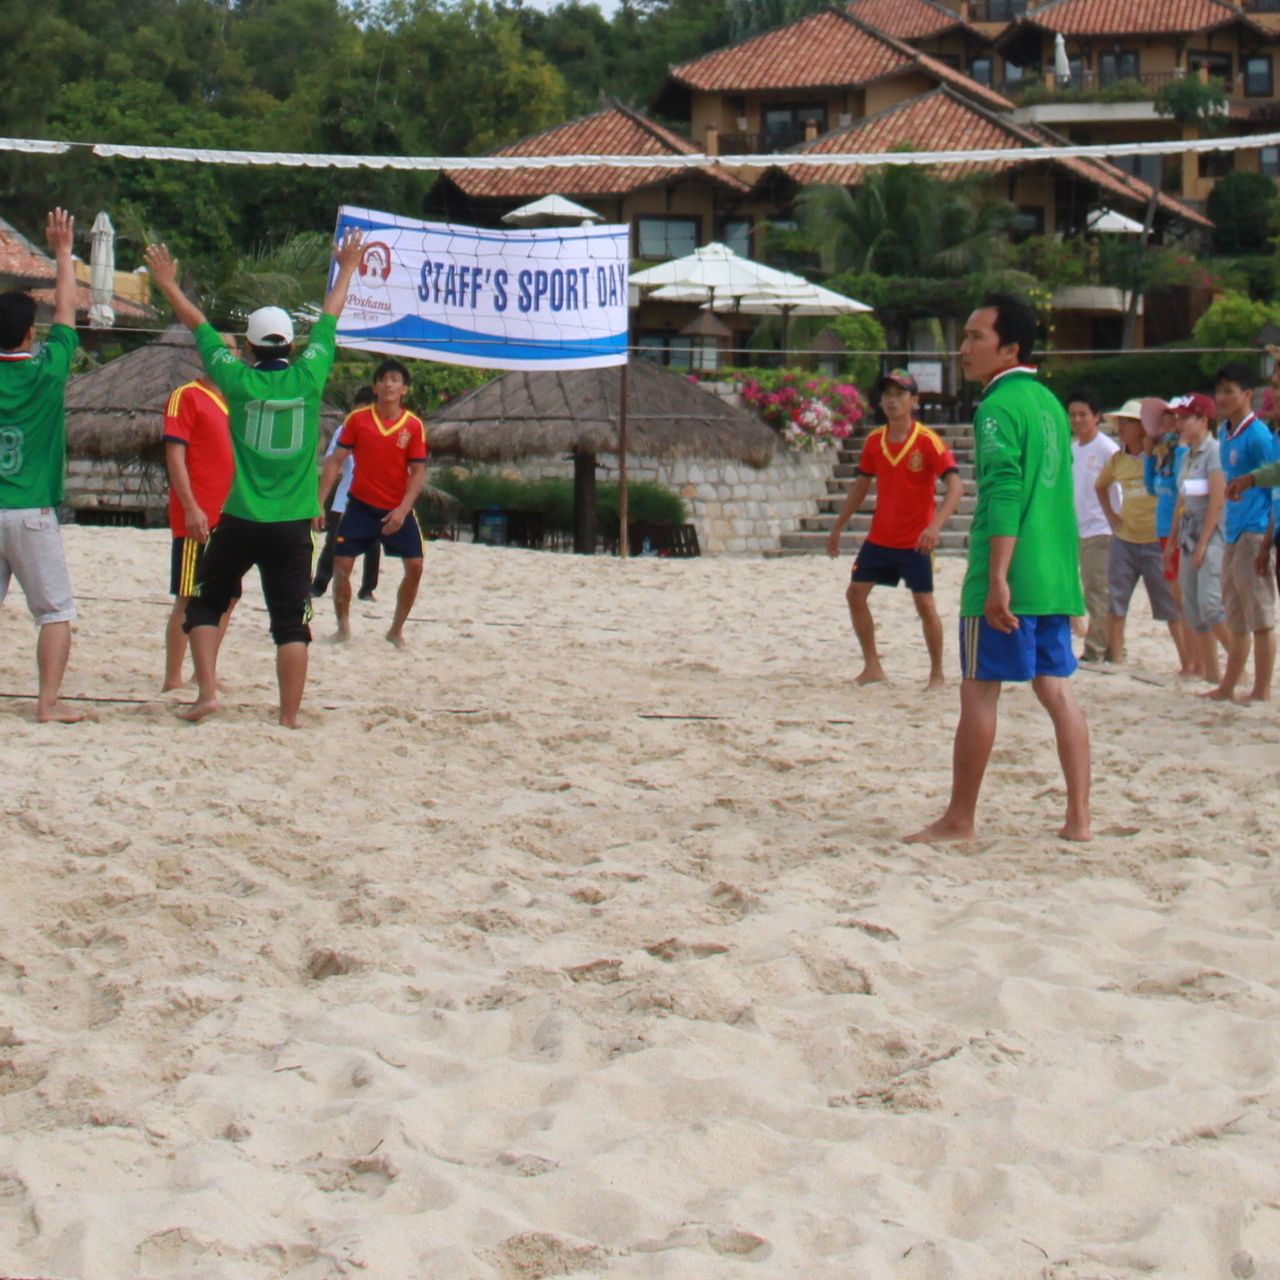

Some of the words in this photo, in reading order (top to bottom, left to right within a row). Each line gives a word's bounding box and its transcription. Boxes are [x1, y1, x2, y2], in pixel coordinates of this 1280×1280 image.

[418, 260, 508, 312] STAFF'S
[518, 267, 589, 313] SPORT
[597, 263, 625, 308] DAY
[244, 397, 305, 456] 10
